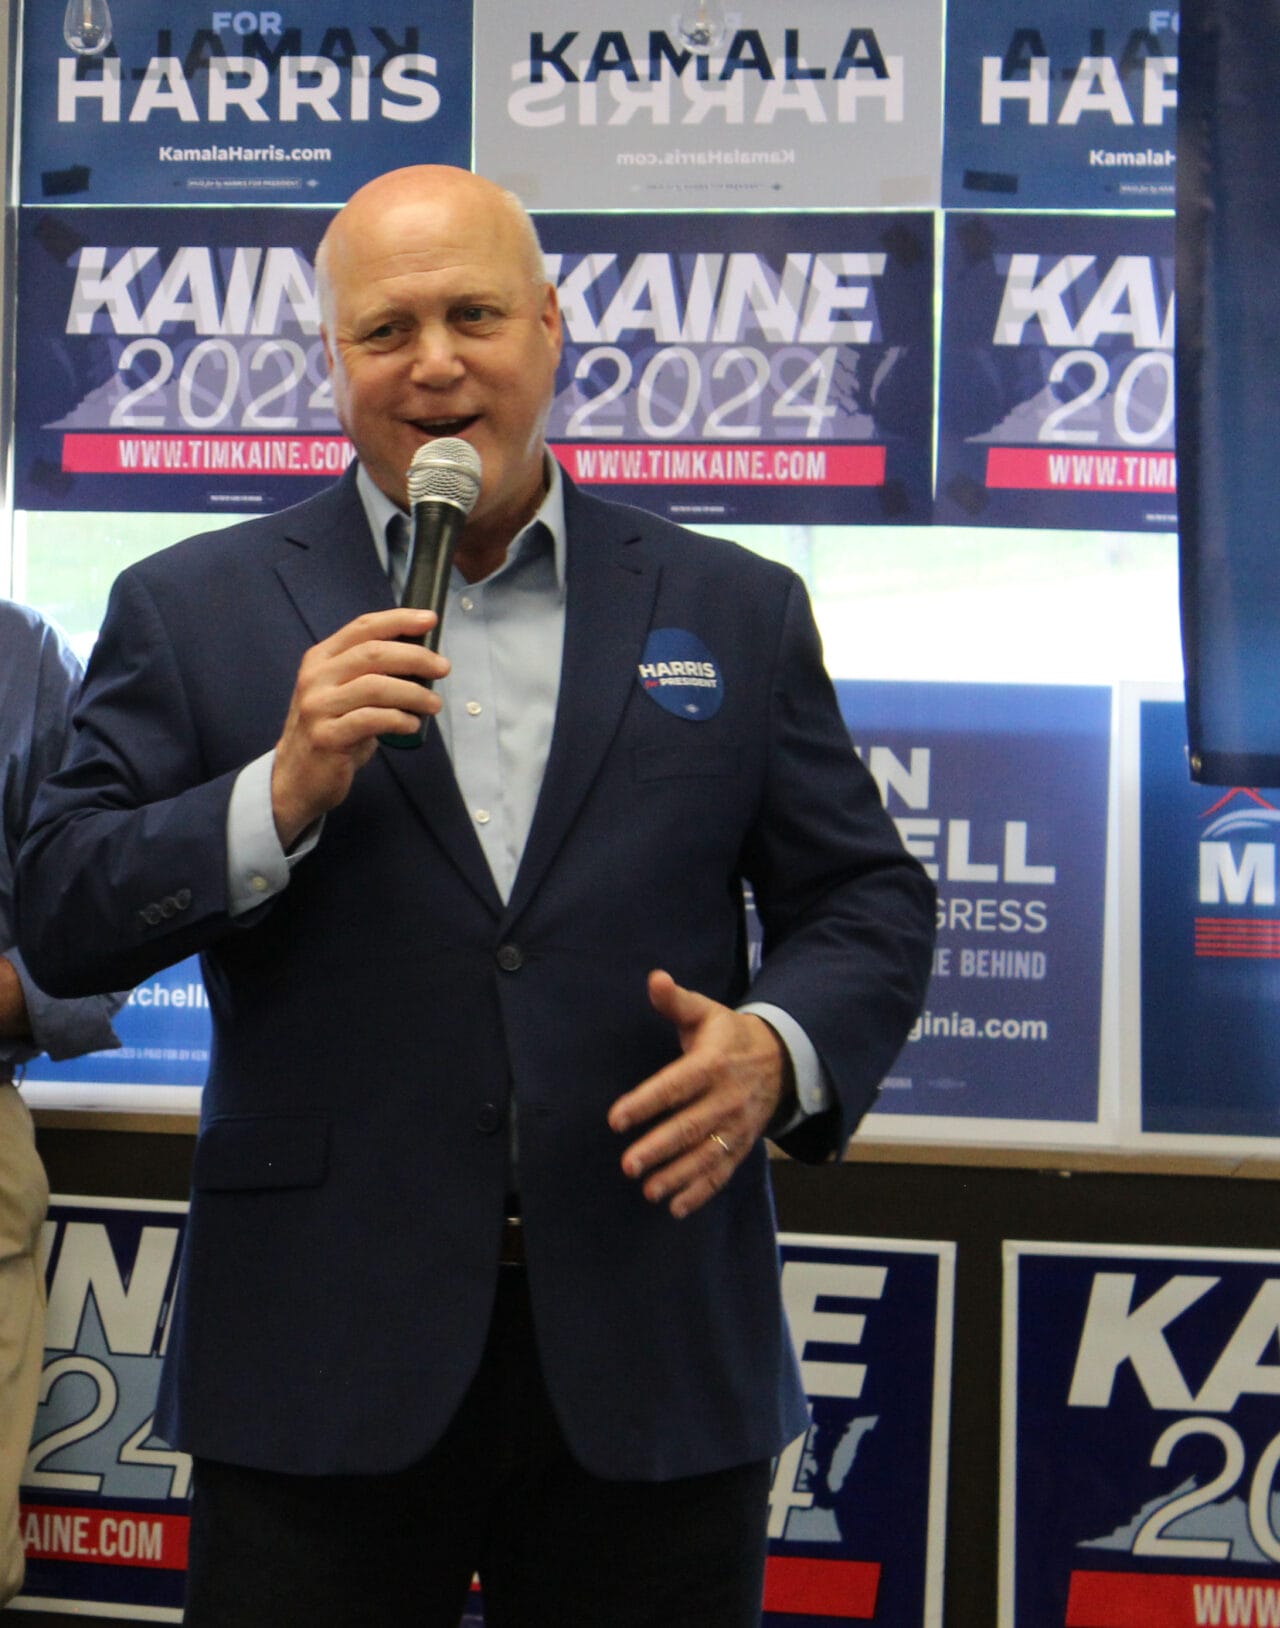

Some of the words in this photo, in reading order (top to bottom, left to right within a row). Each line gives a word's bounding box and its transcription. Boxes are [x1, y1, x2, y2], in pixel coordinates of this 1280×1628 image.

[212, 11, 282, 35] FOR
[529, 28, 891, 83] KAMALA
[57, 53, 442, 122] HARRIS
[159, 145, 331, 162] KamalaHarris.com
[542, 252, 887, 344] KAINE
[993, 253, 1175, 349] KA
[566, 346, 838, 439] 2024
[576, 450, 826, 480] WWW.TIMKAINE.COM
[638, 661, 716, 678] HARRIS
[660, 677, 717, 688] PRESIDENT
[960, 949, 1046, 980] BEHIND
[20, 1512, 163, 1561] AINE.COM
